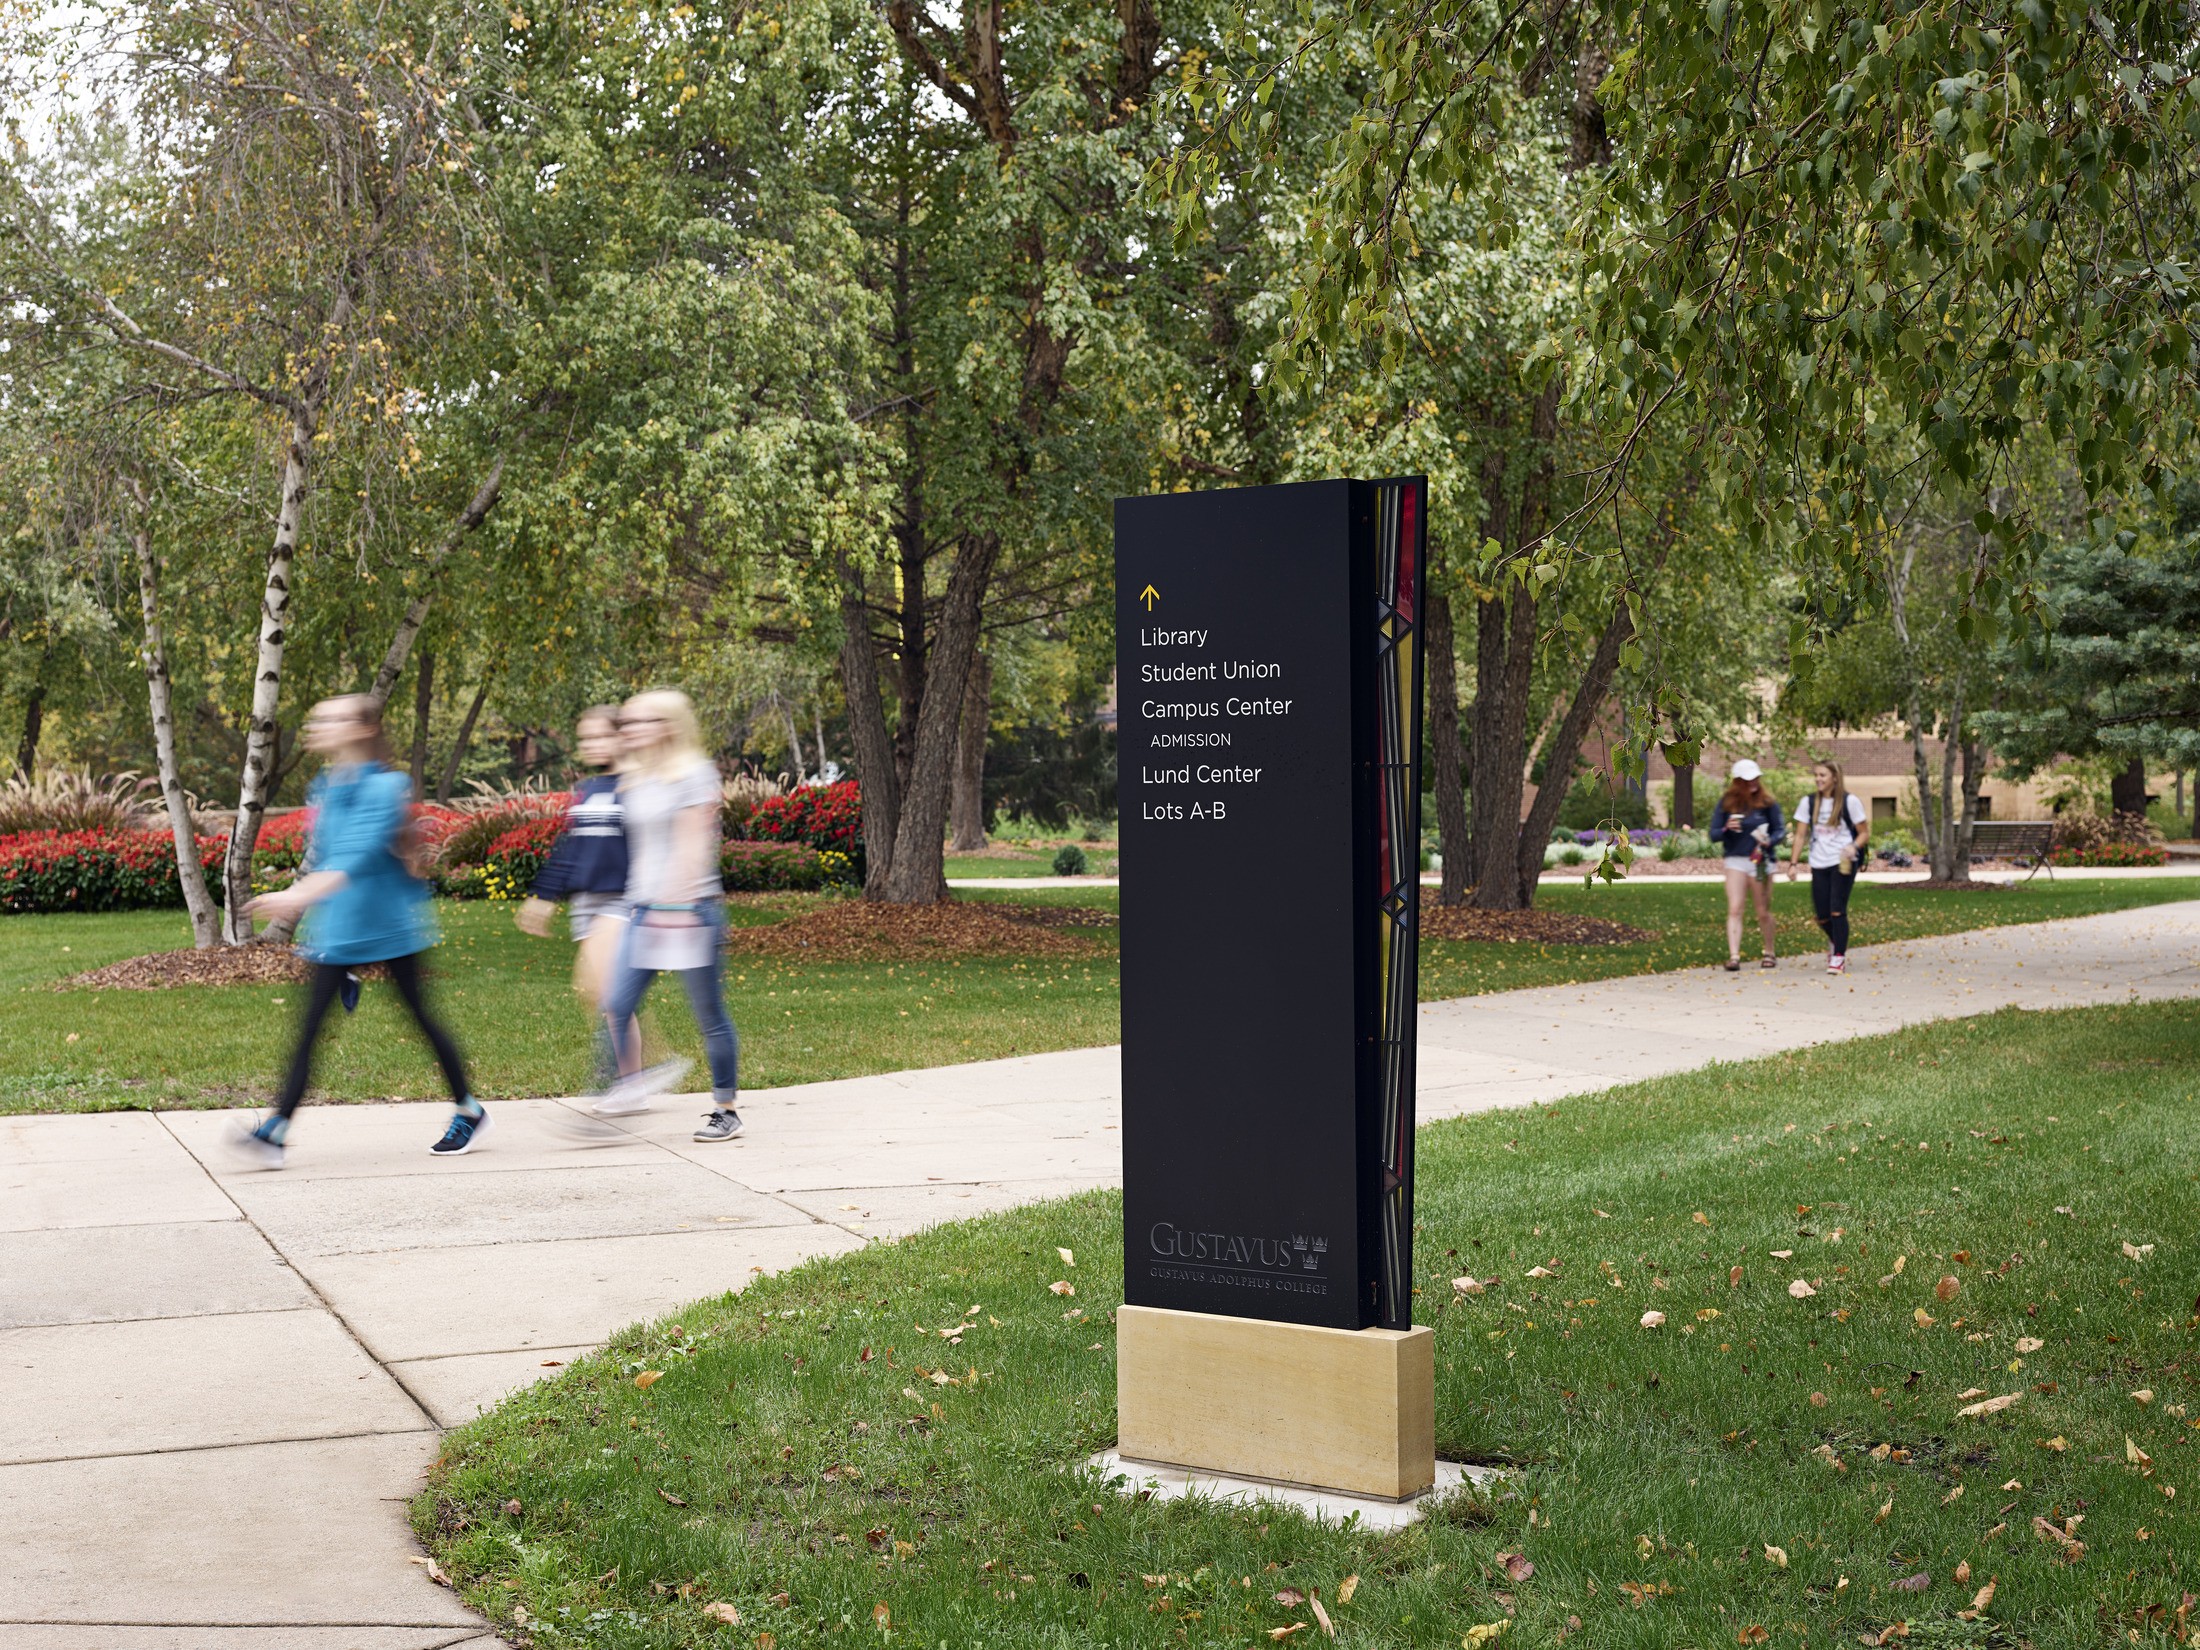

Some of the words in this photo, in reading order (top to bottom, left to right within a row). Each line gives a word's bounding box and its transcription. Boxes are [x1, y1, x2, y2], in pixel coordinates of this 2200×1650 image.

[1141, 627, 1208, 648] Library
[1141, 662, 1217, 683] Student
[1223, 660, 1281, 680] Union
[1141, 700, 1219, 720] Campus
[1226, 697, 1292, 716] Center
[1150, 733, 1231, 748] ADMISSION
[1142, 764, 1190, 784] Lund
[1196, 764, 1262, 783] Center
[1143, 801, 1183, 820] Lots
[1190, 801, 1226, 820] A-B
[1150, 1222, 1292, 1268] GUSTAVUS
[1150, 1267, 1205, 1282] GUSTAVUS
[1209, 1273, 1271, 1289] ADOLPHUS
[1275, 1280, 1328, 1296] COLLEGE
